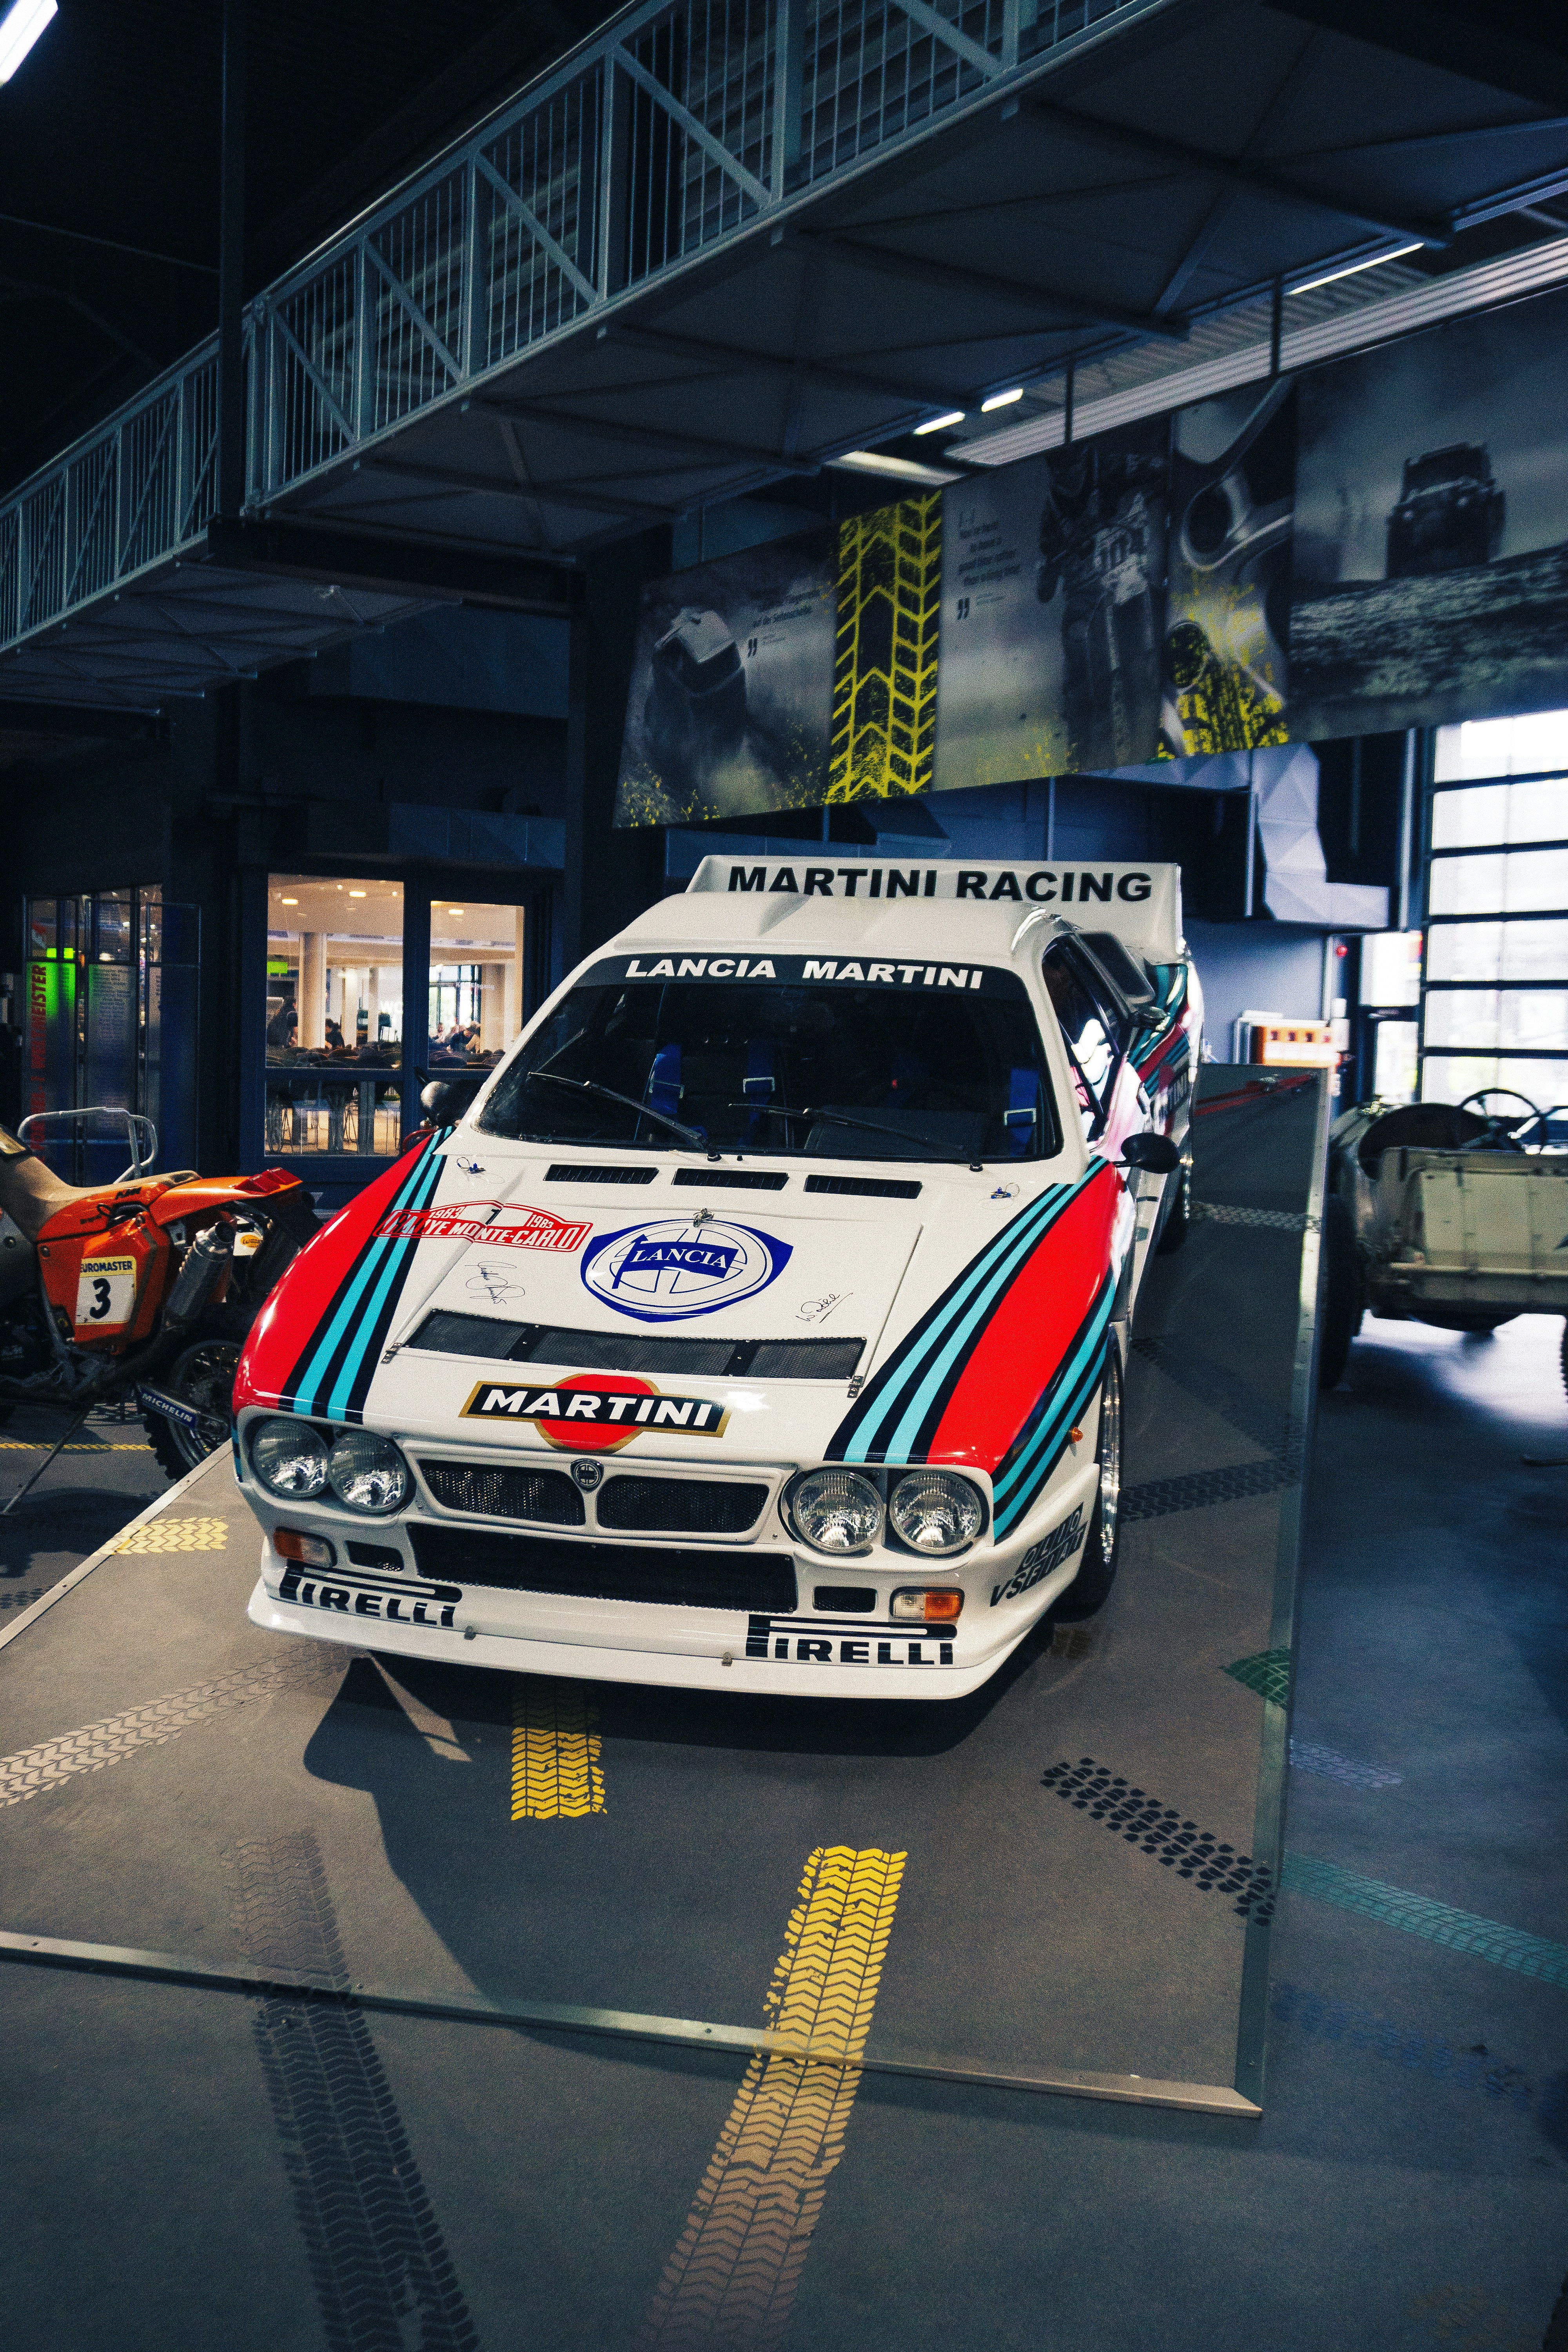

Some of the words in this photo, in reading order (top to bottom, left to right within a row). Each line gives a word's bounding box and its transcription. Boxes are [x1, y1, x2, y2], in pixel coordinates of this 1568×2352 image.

[728, 866, 937, 898] MARTINI
[956, 870, 1152, 902] RACING
[625, 959, 777, 978] LANCIA
[802, 960, 984, 989] MARTINI
[31, 964, 46, 1070] WELTMEISTER
[383, 1212, 446, 1235] RALLYE
[451, 1221, 581, 1249] MONTE-CARLO
[429, 1205, 463, 1220] 1983
[485, 1209, 503, 1225] 1
[527, 1214, 554, 1229] 1983
[630, 1248, 727, 1269] LANCIA
[89, 1278, 111, 1319] 3
[142, 1393, 192, 1423] MICHELIN
[481, 1389, 713, 1426] MARTINI
[279, 1559, 463, 1628] PIRELLI
[745, 1614, 957, 1665] PIRELLI
